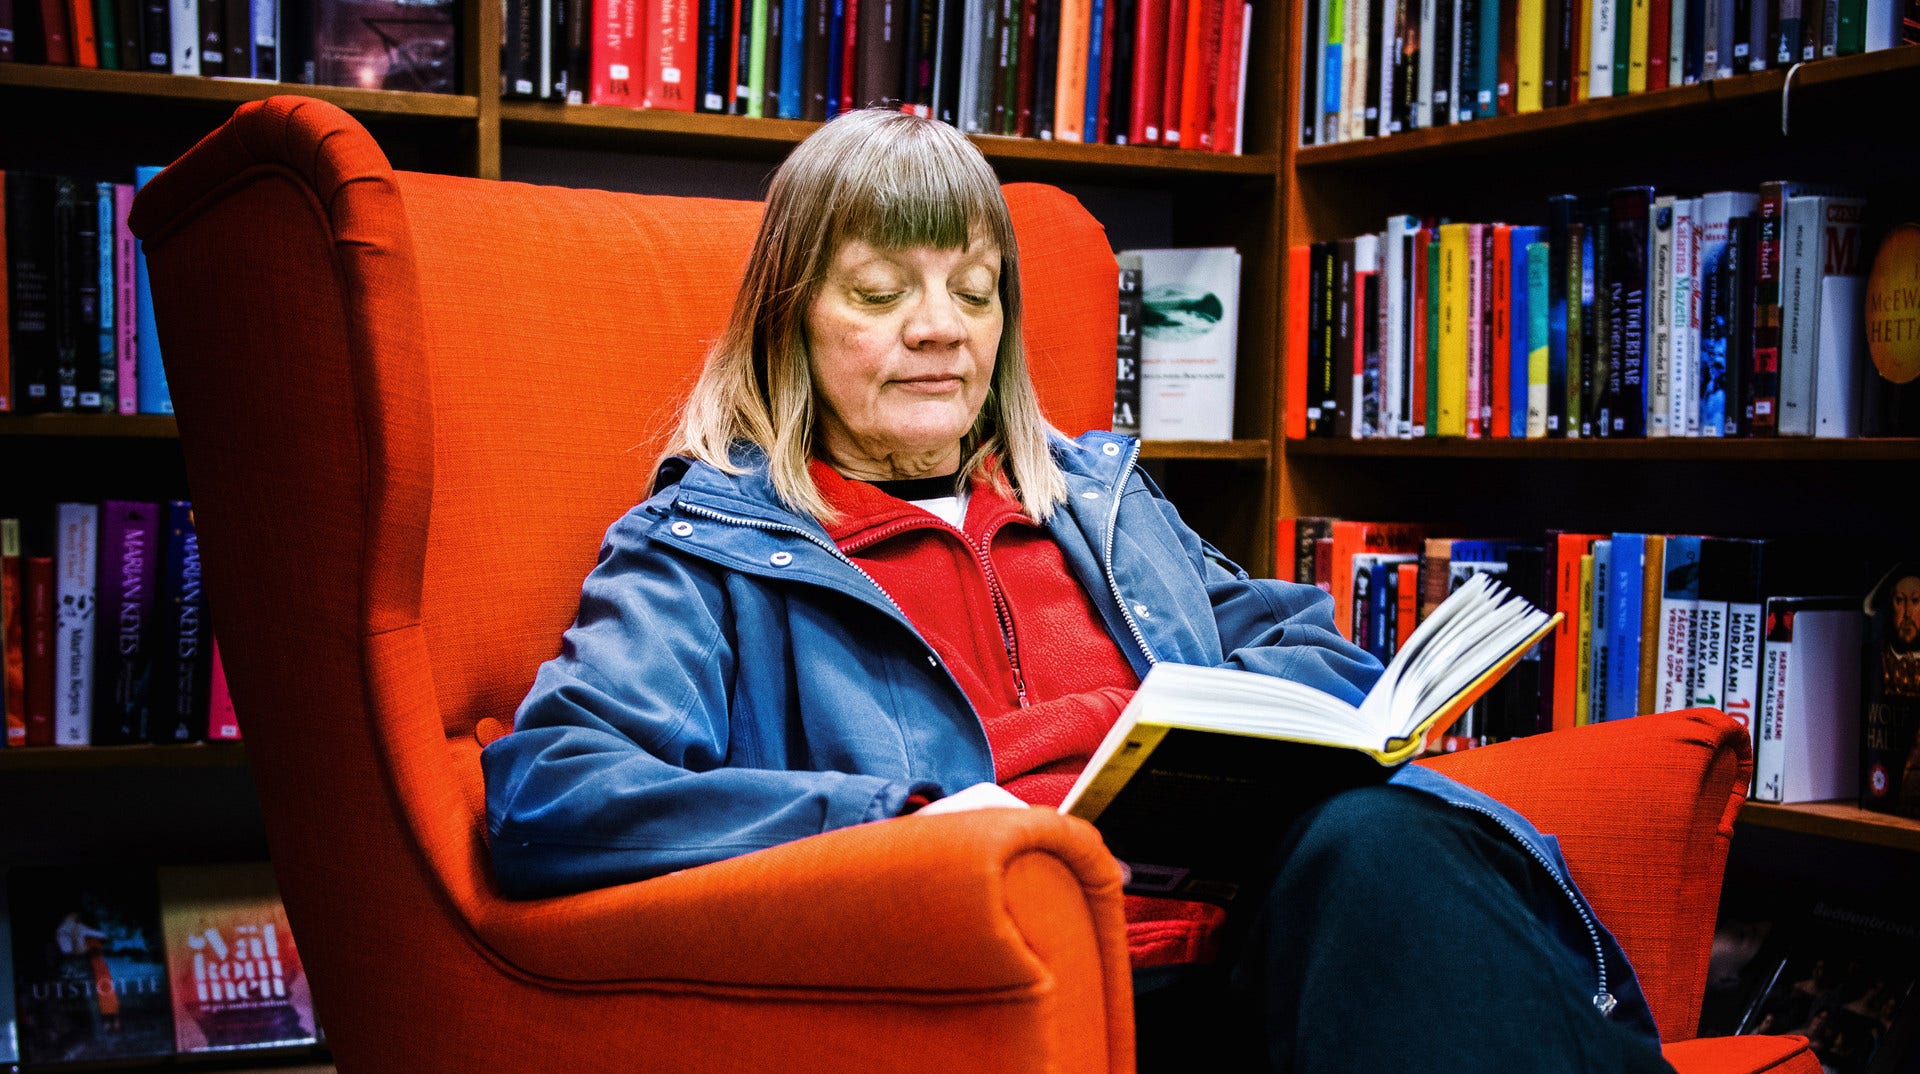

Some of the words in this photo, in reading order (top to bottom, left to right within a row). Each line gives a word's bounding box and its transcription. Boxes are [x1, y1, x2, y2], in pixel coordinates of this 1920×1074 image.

[1762, 202, 1776, 218] Ib
[1675, 215, 1690, 274] Katarina
[1760, 222, 1776, 280] Michael
[1674, 276, 1690, 328] Mazetti
[121, 528, 145, 599] MARIAN
[69, 627, 83, 676] Marian
[119, 602, 140, 655] KEYES
[178, 605, 200, 658] KEYES
[1667, 608, 1677, 651] VRIDER
[1674, 608, 1687, 654] FÅGELN
[1696, 610, 1710, 689] MURAKAMI
[1709, 611, 1721, 665] HARUKI
[1728, 612, 1741, 693] MURAKAMI
[1742, 613, 1755, 669] HARUKI
[1666, 654, 1675, 679] UPP
[1674, 658, 1684, 684] SOM
[1777, 651, 1788, 687] HARUKI
[67, 679, 81, 716] Keyes
[1663, 681, 1675, 711] VÄRL
[1764, 650, 1777, 741] SPUTNIKÄLSKLING
[1774, 691, 1786, 741] MURAKAMI
